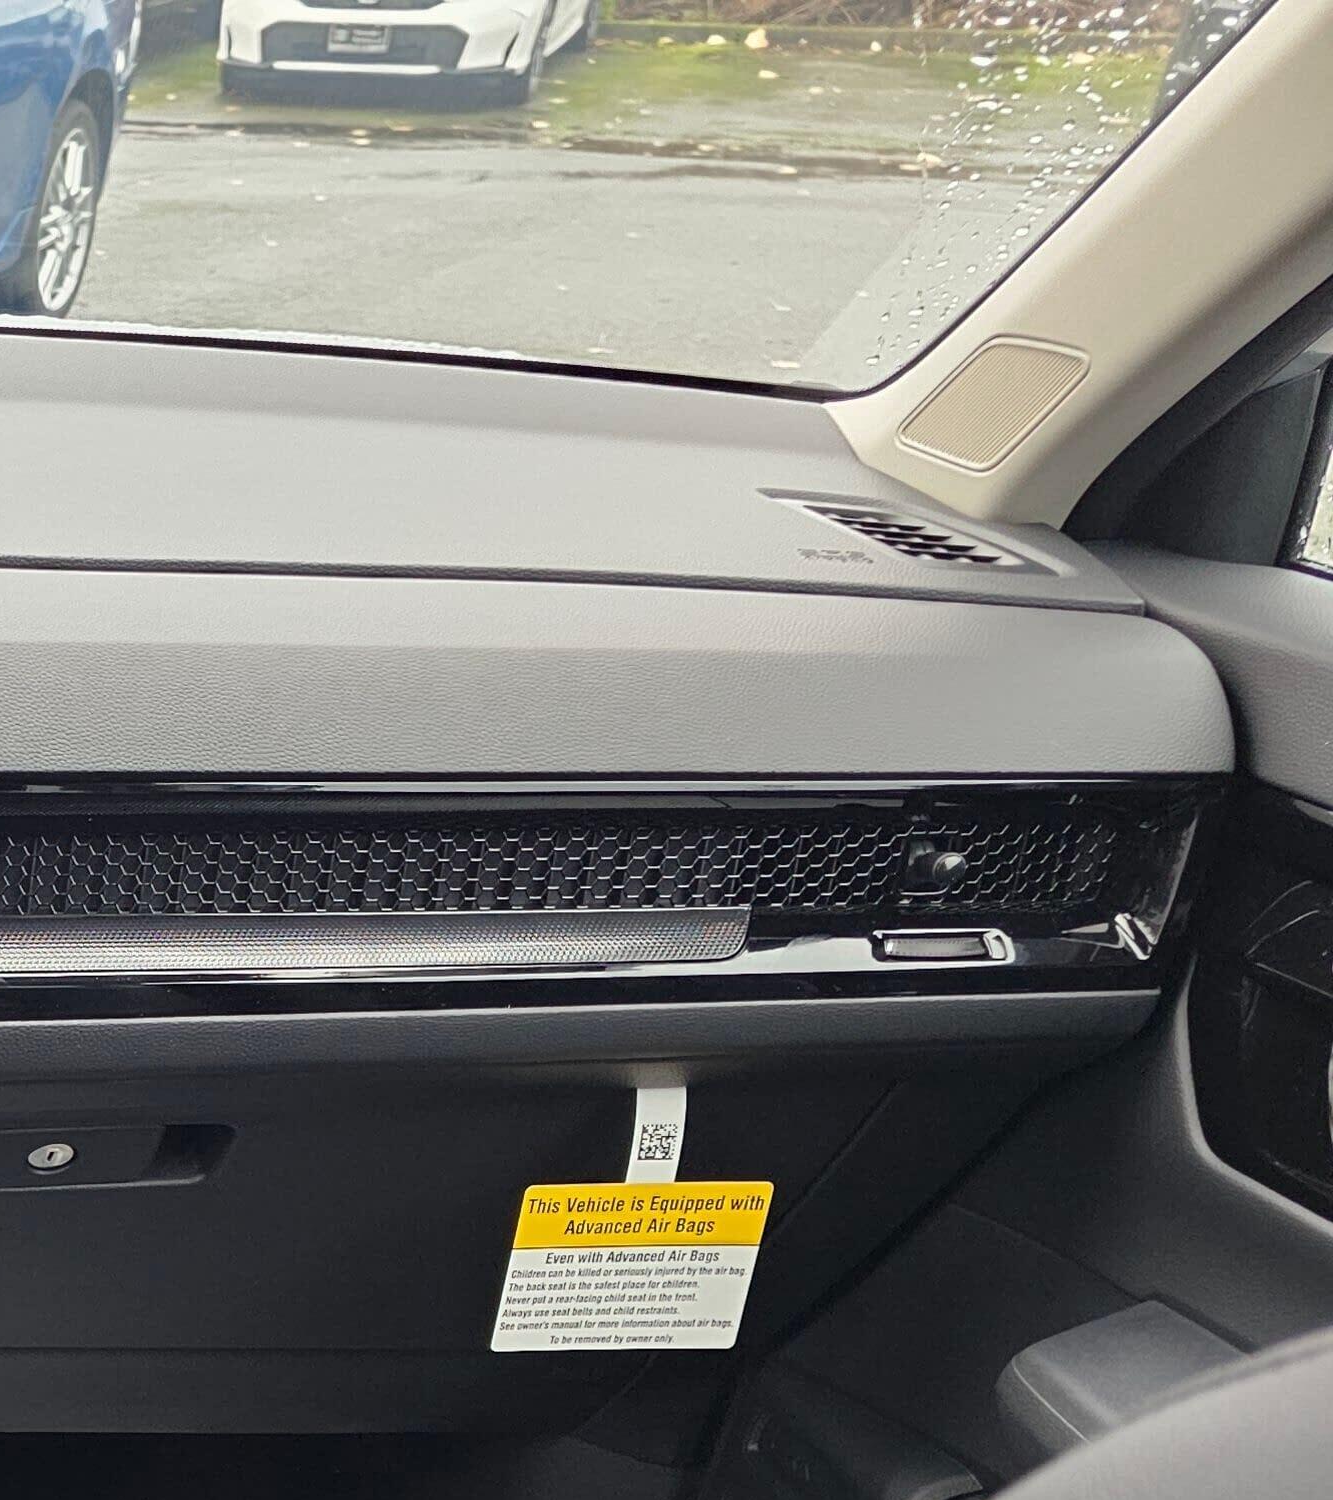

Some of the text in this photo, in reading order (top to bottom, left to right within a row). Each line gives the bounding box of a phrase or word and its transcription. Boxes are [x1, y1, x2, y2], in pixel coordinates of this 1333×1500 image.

[528, 1195, 765, 1214] This Vehicle is Equipped with
[564, 1217, 715, 1236] Advanced Air Bags
[546, 1250, 721, 1265] Even with Advanced Air Bags
[511, 1269, 546, 1279] Children
[565, 1268, 576, 1277] be
[577, 1268, 602, 1277] killed
[603, 1269, 612, 1277] or
[614, 1267, 653, 1277] seriously
[655, 1266, 685, 1277] injured
[686, 1266, 697, 1276] by
[699, 1266, 713, 1275] the
[714, 1266, 728, 1275] air
[508, 1282, 524, 1292] The
[526, 1281, 546, 1291] back
[548, 1282, 567, 1291] seat
[568, 1281, 577, 1290] is
[578, 1281, 592, 1290] the
[594, 1280, 620, 1290] safest
[621, 1280, 646, 1290] place
[647, 1280, 660, 1289] for
[505, 1295, 531, 1305] Never
[532, 1295, 546, 1306] put
[555, 1294, 603, 1305] rear-facing
[604, 1293, 626, 1303] child
[628, 1293, 647, 1302] seat
[648, 1293, 657, 1301] in
[658, 1292, 673, 1301] the
[502, 1308, 532, 1319] Always
[552, 1308, 571, 1317] seat
[572, 1307, 593, 1316] belts
[595, 1307, 611, 1316] and
[613, 1306, 635, 1315] child
[499, 1321, 515, 1331] See
[517, 1320, 550, 1330] owner's
[551, 1320, 582, 1329] manual
[583, 1319, 596, 1328] for
[621, 1319, 670, 1328] information
[671, 1319, 696, 1328] about
[696, 1318, 710, 1327] air
[549, 1335, 560, 1344] To
[561, 1335, 573, 1344] be
[574, 1334, 612, 1344] removed
[613, 1334, 624, 1344] by
